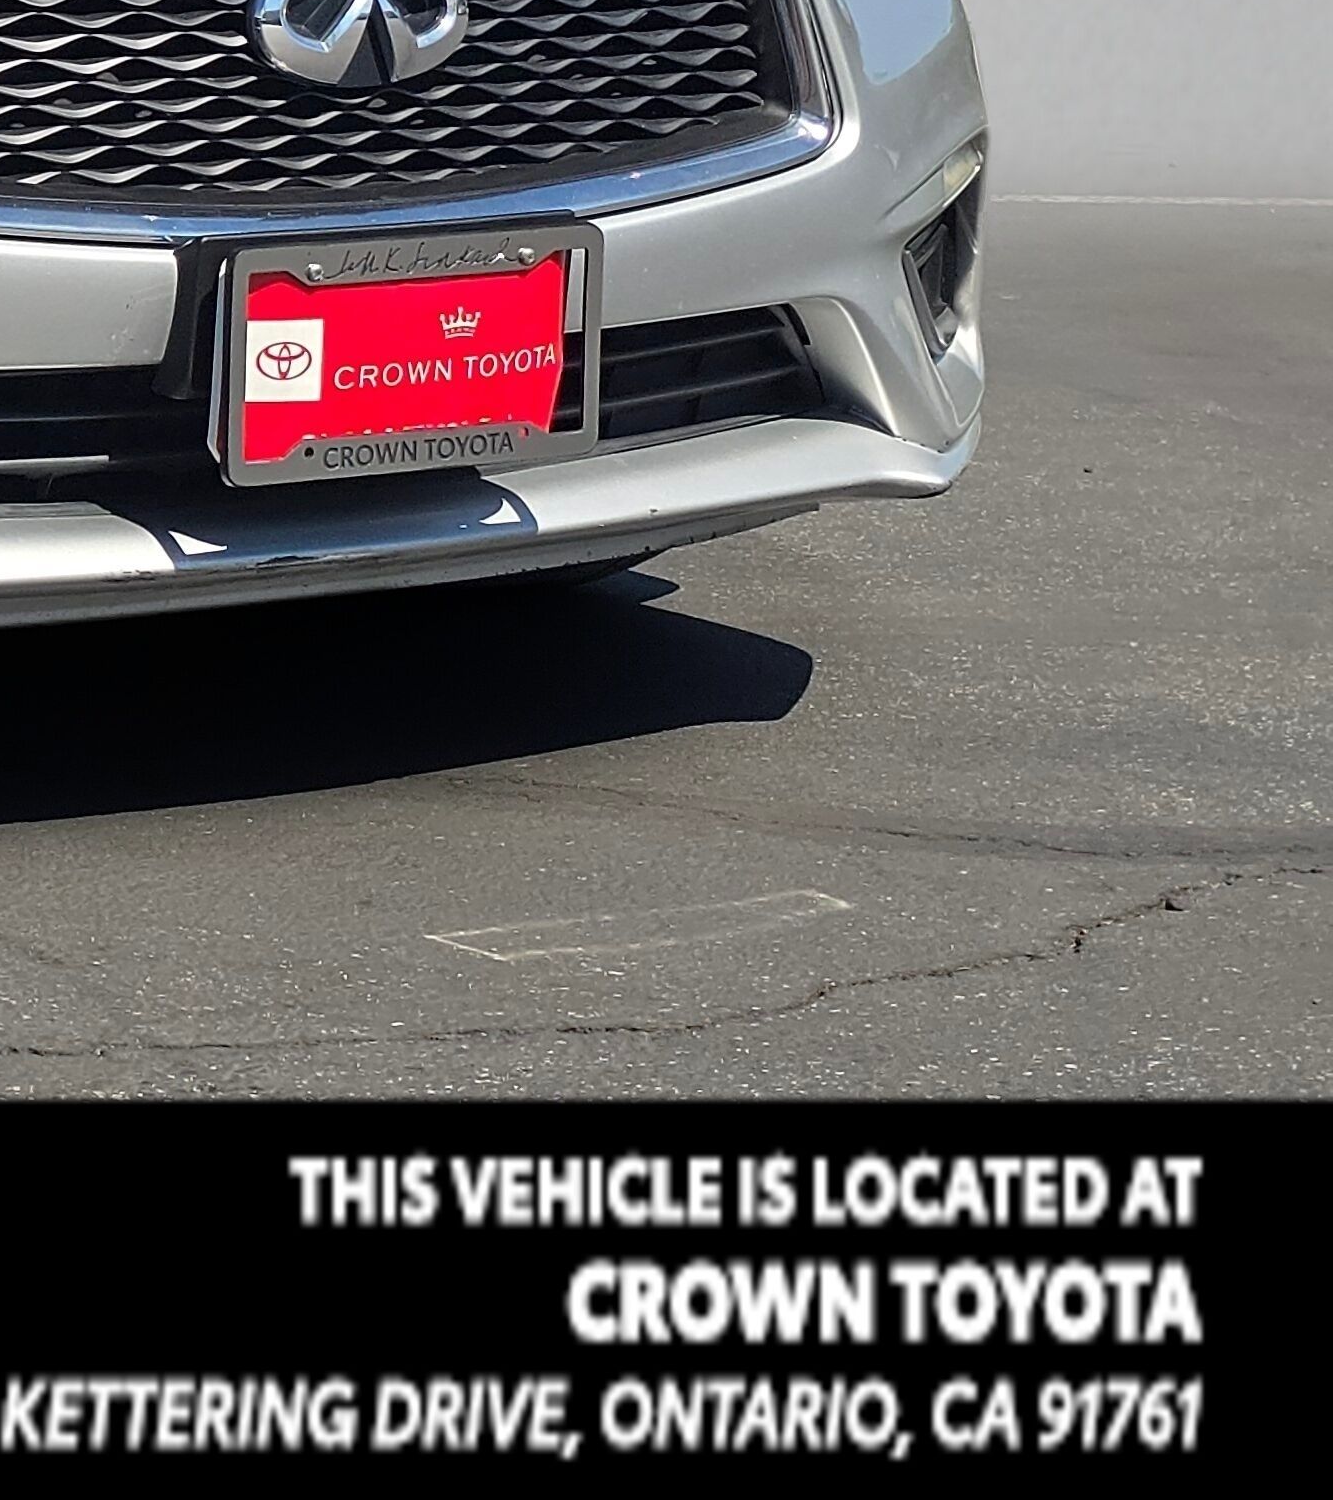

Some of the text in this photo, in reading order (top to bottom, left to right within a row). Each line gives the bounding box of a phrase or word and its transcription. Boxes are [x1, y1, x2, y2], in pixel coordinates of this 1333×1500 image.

[333, 343, 556, 389] CROWN TOYOTA
[323, 431, 514, 469] CROWN TOYOTA
